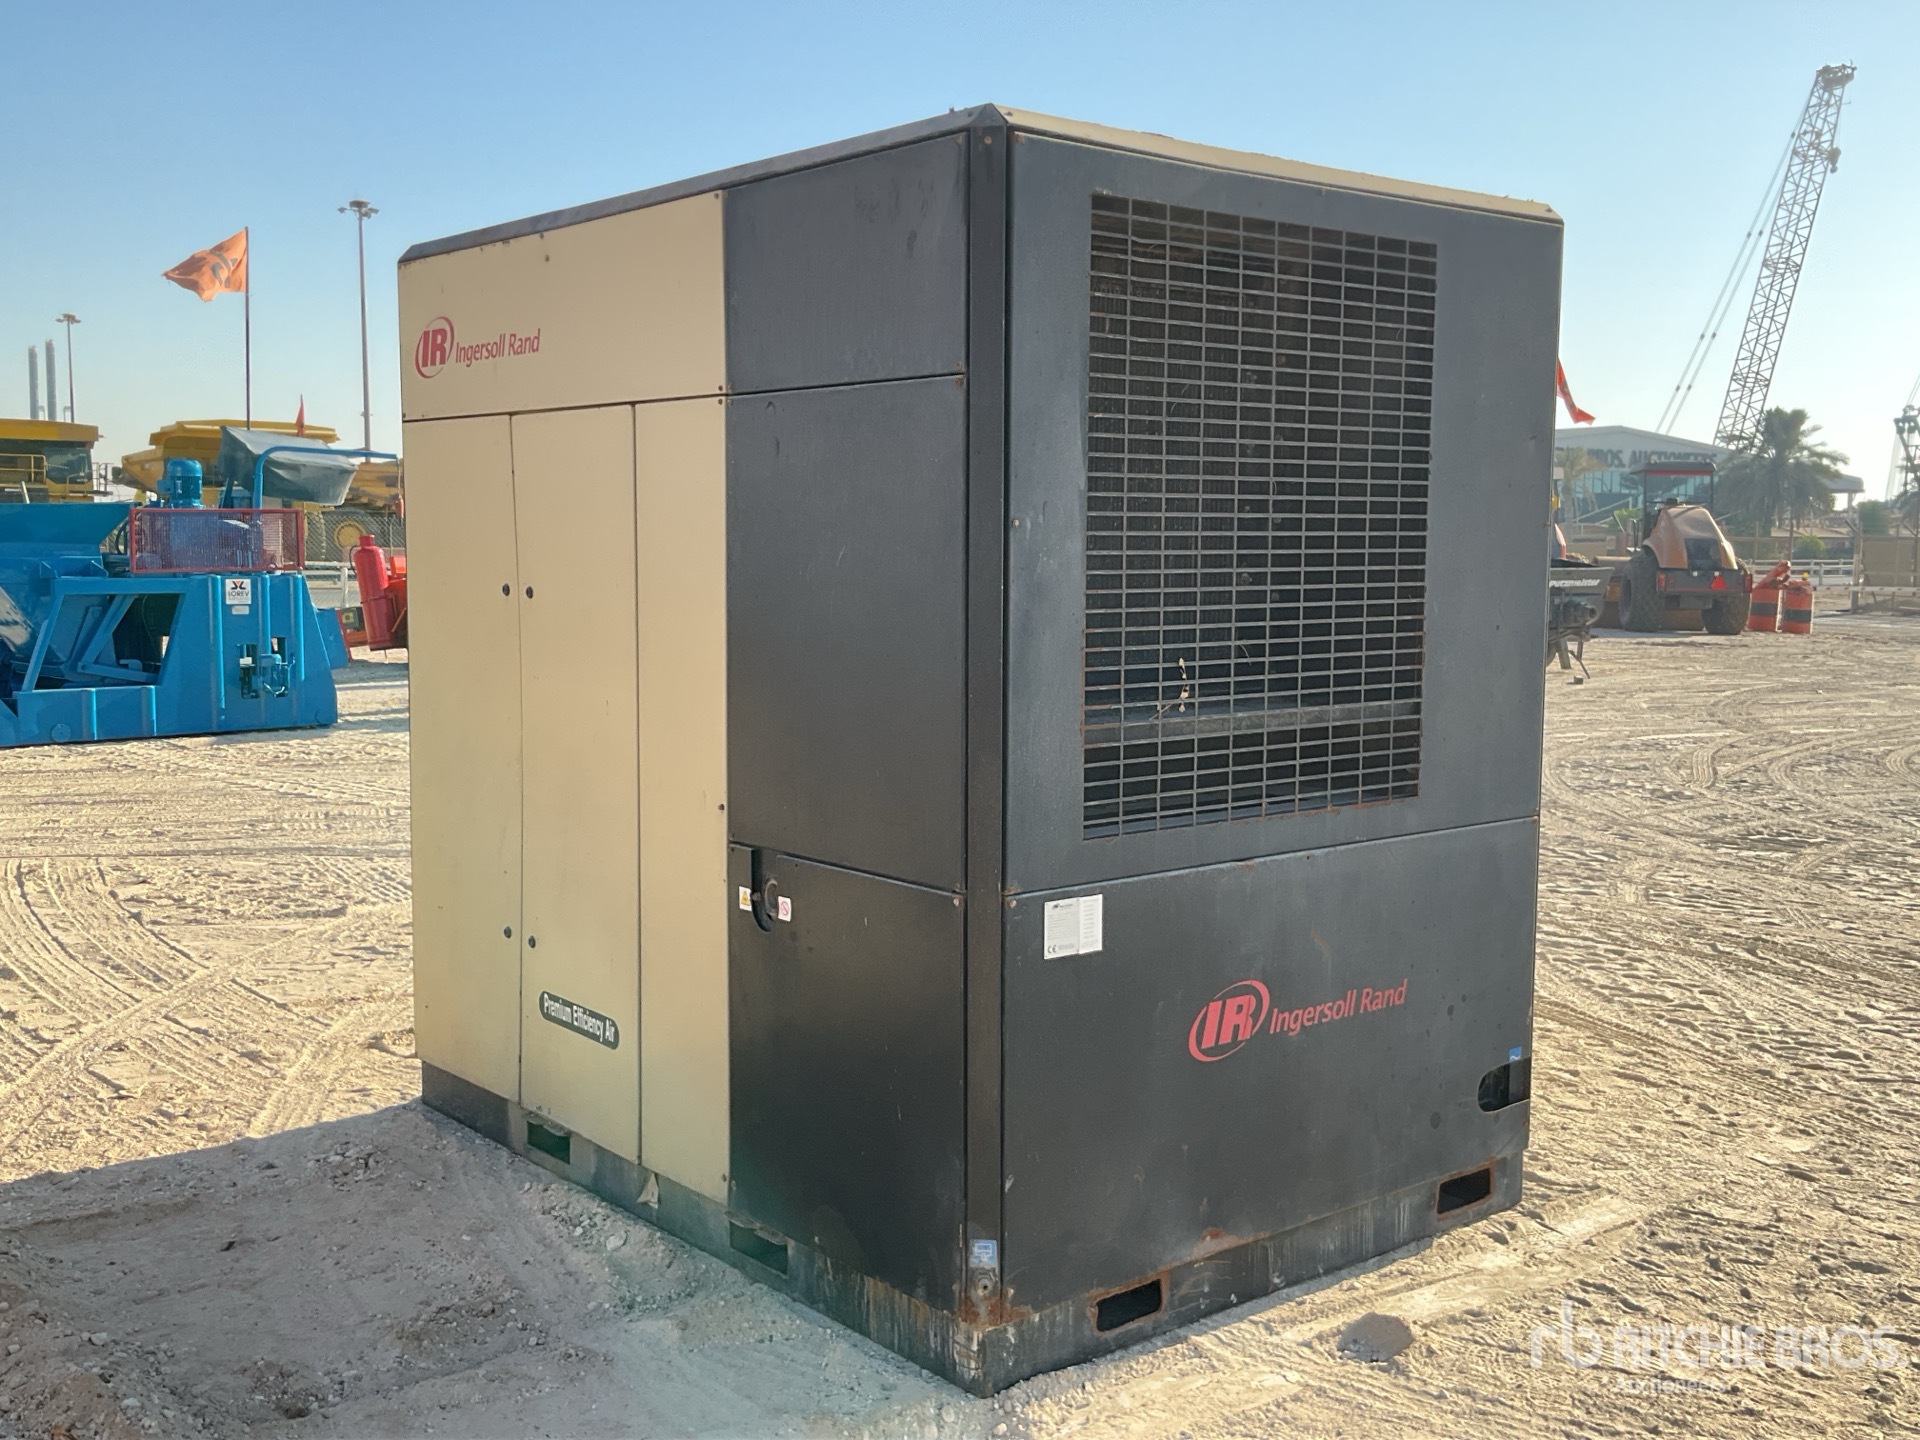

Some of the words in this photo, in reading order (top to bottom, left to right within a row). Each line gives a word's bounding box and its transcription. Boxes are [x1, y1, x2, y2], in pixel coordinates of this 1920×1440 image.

[455, 333, 506, 368] Ingersoll
[508, 328, 542, 357] Rand
[543, 992, 572, 1024] Premium
[573, 1005, 604, 1043] Efficiency
[605, 1018, 615, 1043] Air
[1269, 989, 1357, 1036] Ingersoll
[1359, 978, 1408, 1014] Rand
